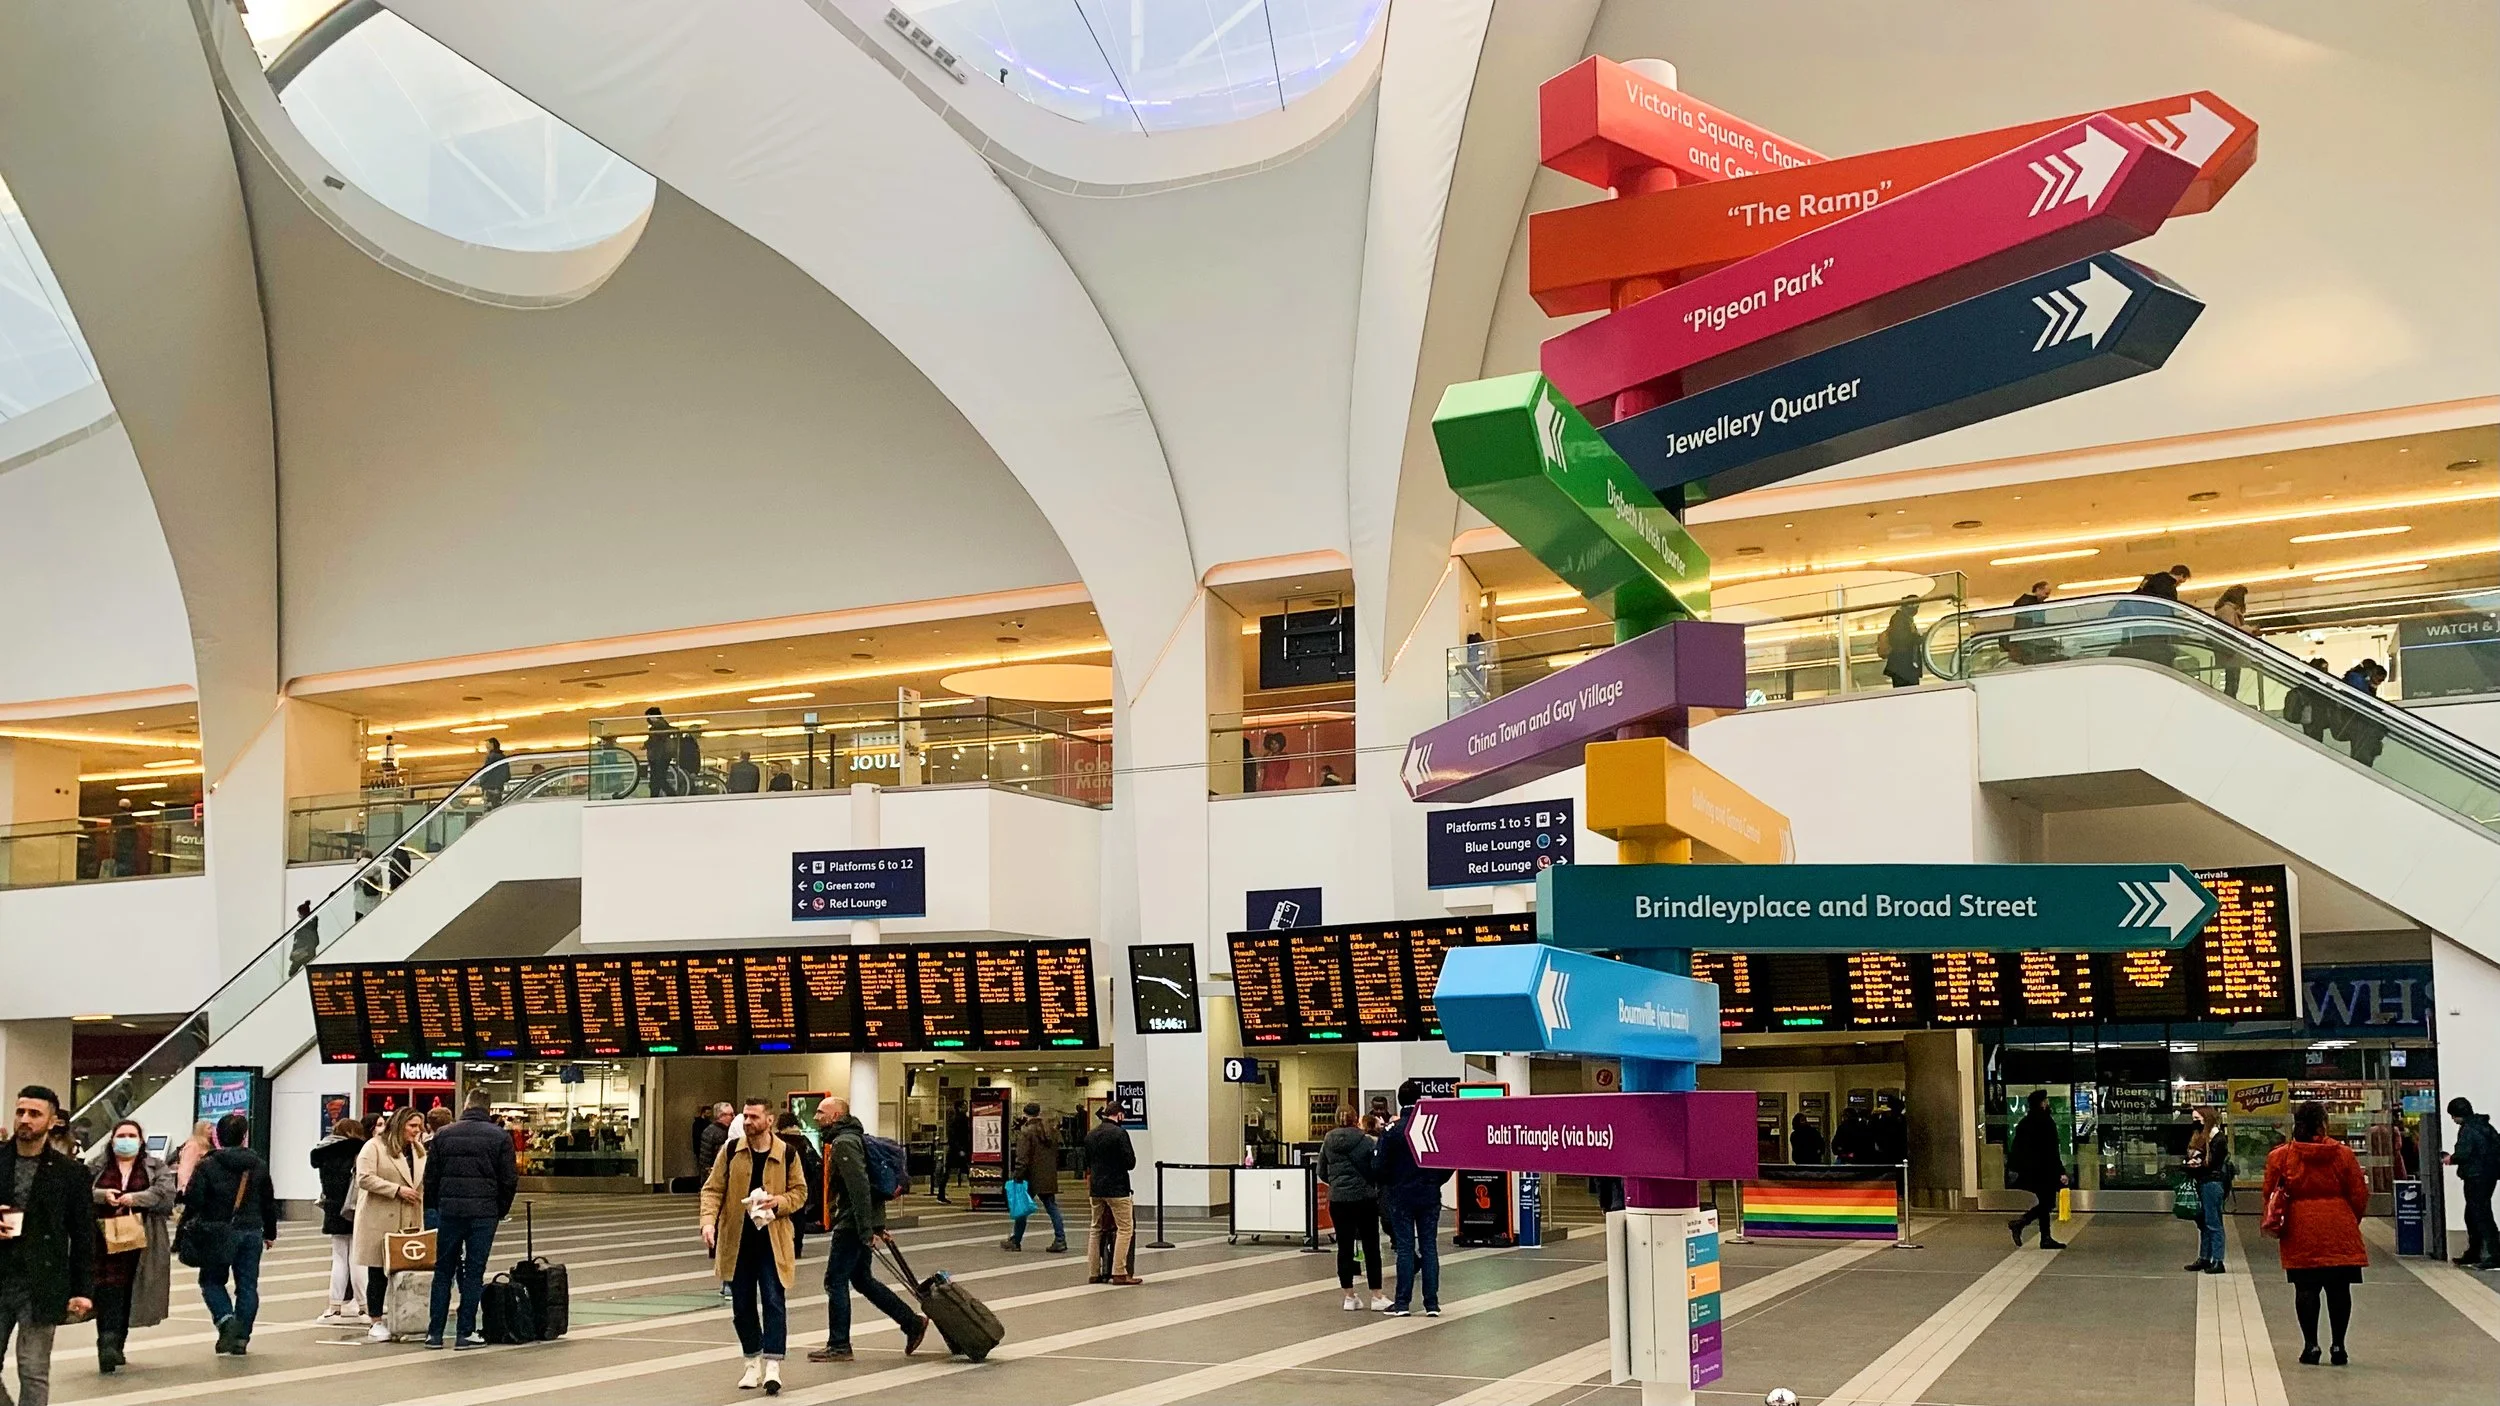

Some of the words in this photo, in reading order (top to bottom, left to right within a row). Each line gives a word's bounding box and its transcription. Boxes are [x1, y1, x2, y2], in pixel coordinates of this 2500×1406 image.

[1625, 79, 1693, 128] Victoria
[1697, 112, 1758, 160] Square,
[1761, 140, 1811, 169] Cham
[1689, 146, 1720, 173] and
[1724, 157, 1760, 180] Cen
[1666, 410, 1764, 458] Jewellery
[1770, 377, 1861, 424] Quarter
[1607, 478, 1638, 531] Digbeth
[1638, 511, 1645, 538] &
[1645, 518, 1661, 555] Irish
[1661, 535, 1686, 577] Quarter
[2426, 622, 2478, 637] WATCH
[2482, 621, 2493, 631] &
[1468, 732, 1497, 756] China
[1499, 719, 1527, 744] Town
[1528, 703, 1550, 731] and
[1553, 698, 1577, 722] Gay
[1579, 680, 1624, 711] Village
[850, 751, 927, 771] JOULS
[1446, 820, 1497, 834] Platforms
[1500, 818, 1506, 829] 1
[1509, 818, 1521, 829] to
[1524, 817, 1531, 827] 5
[1465, 842, 1488, 853] Blue
[1491, 839, 1531, 852] Lounge
[829, 861, 876, 872] Platforms
[878, 860, 885, 870] 6
[887, 860, 898, 870] to
[900, 859, 913, 869] 12
[1468, 862, 1489, 874] Red
[1491, 860, 1532, 873] Lounge
[2194, 871, 2229, 880] Arrivals
[826, 881, 852, 891] Green
[854, 882, 876, 890] zone
[829, 898, 849, 909] Red
[851, 898, 887, 910] Lounge
[1635, 894, 1811, 924] Brindleyplace
[1818, 894, 1868, 917] and
[1876, 894, 1952, 917] Broad
[1959, 894, 2038, 917] Street
[1619, 997, 1656, 1027] Bournville
[1656, 1003, 1670, 1031] (via
[2052, 1011, 2069, 1019] Page
[2210, 1006, 2231, 1015] Page
[400, 1062, 448, 1080] NatWest
[201, 1088, 247, 1108] RAILCARD
[1118, 1085, 1144, 1097] Tickets
[2236, 1086, 2271, 1099] GREAT
[2111, 1100, 2146, 1109] Wines
[2149, 1100, 2157, 1108] &
[2245, 1094, 2281, 1106] VALUE
[1487, 1124, 1511, 1145] Balti
[1513, 1124, 1559, 1151] Triangle
[1562, 1124, 1584, 1149] (via
[1587, 1124, 1614, 1150] bus)
